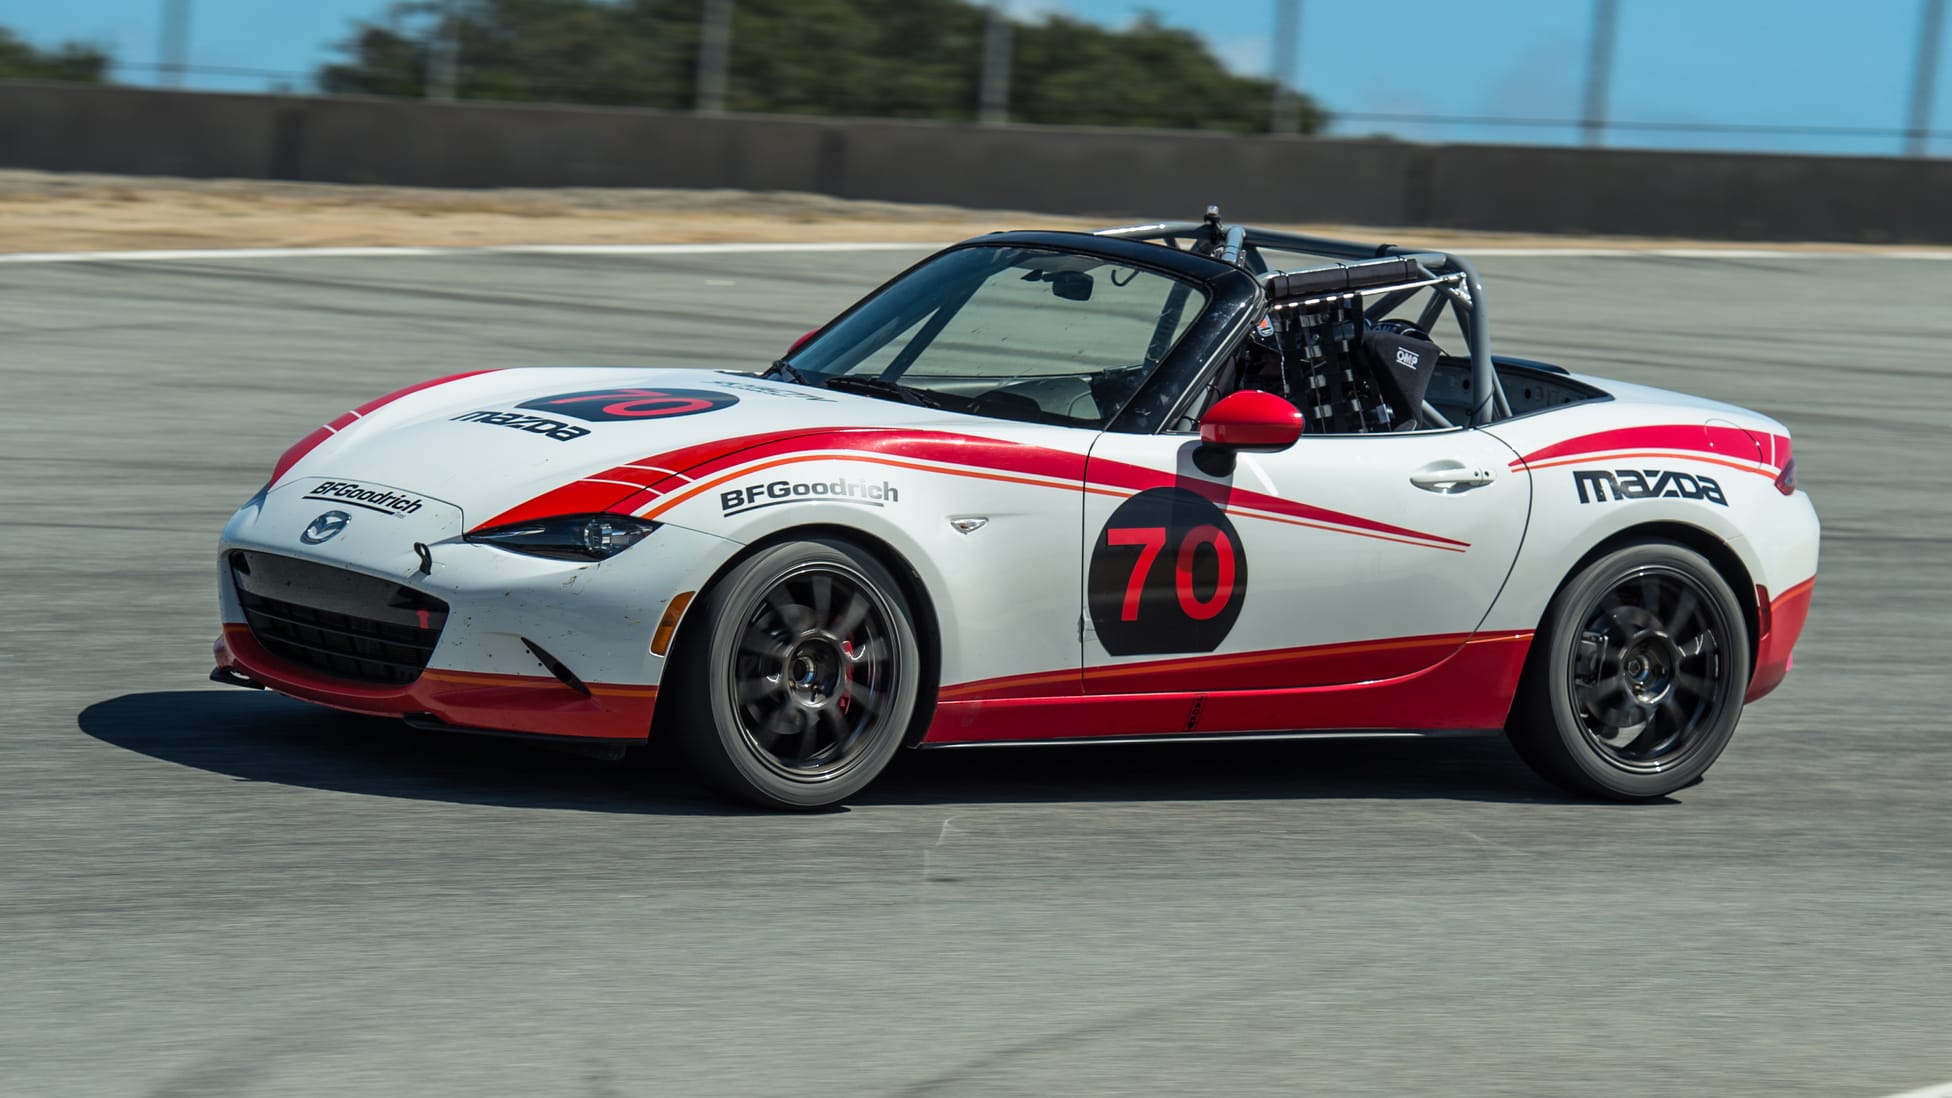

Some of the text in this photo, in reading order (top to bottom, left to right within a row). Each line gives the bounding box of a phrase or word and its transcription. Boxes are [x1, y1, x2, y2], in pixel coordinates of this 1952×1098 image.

[1396, 350, 1418, 367] OMP
[549, 388, 714, 417] 70
[309, 481, 423, 514] BFGoodrich
[720, 477, 900, 512] BFGoodrich
[1107, 524, 1236, 622] 70
